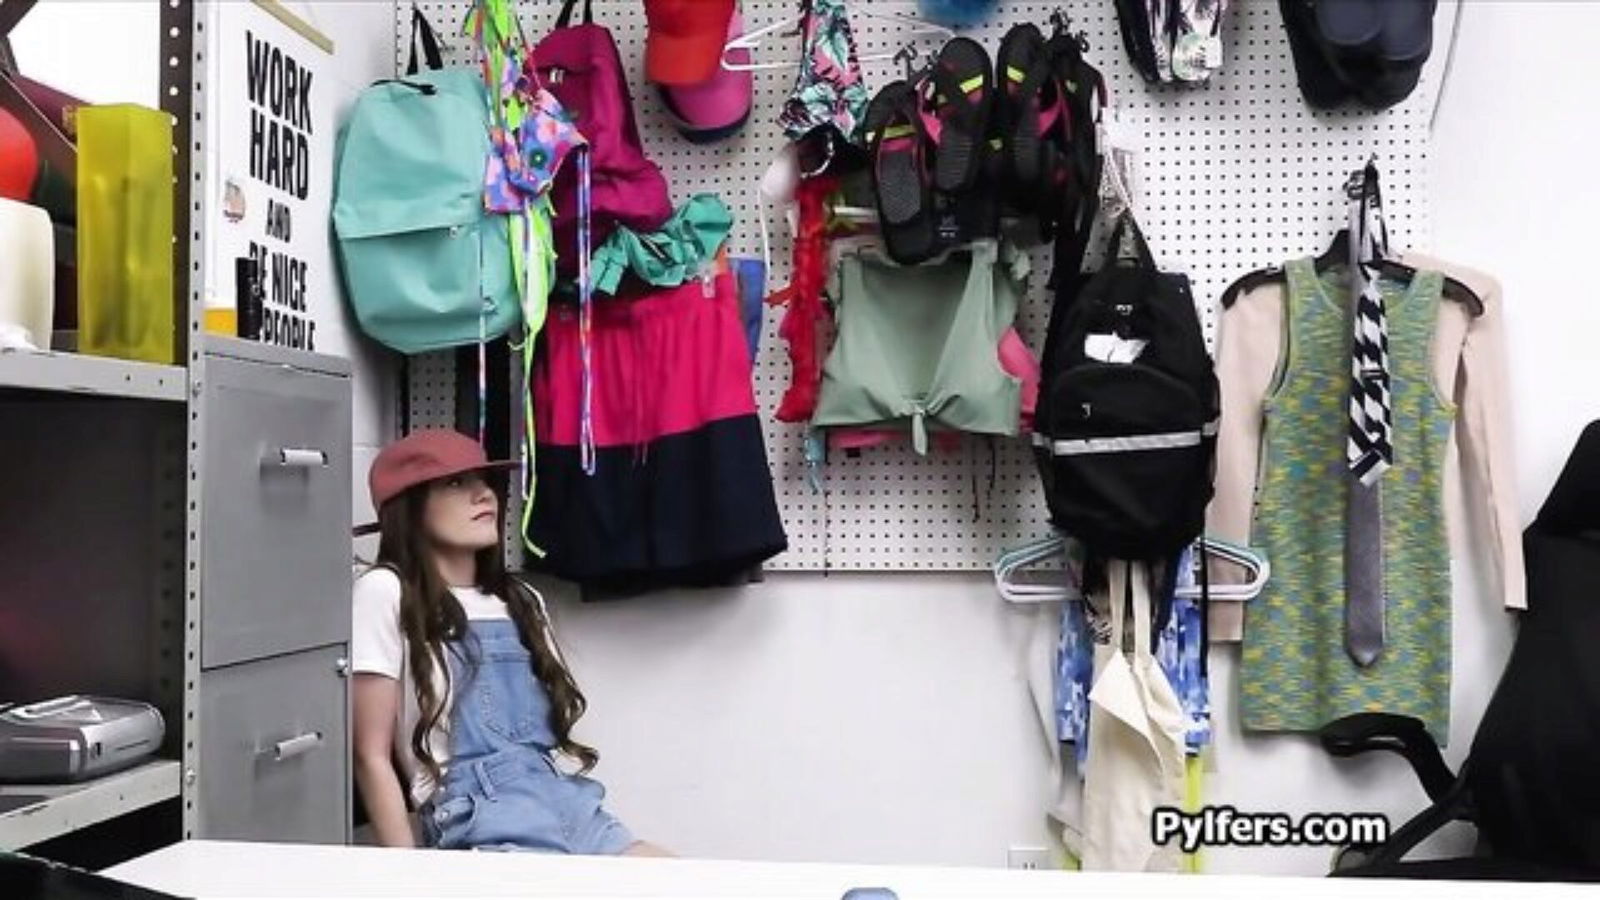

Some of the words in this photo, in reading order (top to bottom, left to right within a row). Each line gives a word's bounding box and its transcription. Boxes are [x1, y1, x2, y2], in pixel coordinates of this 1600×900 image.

[246, 30, 313, 135] WORK
[250, 107, 309, 200] HARD
[265, 198, 291, 243] AND
[272, 251, 308, 312] NICE
